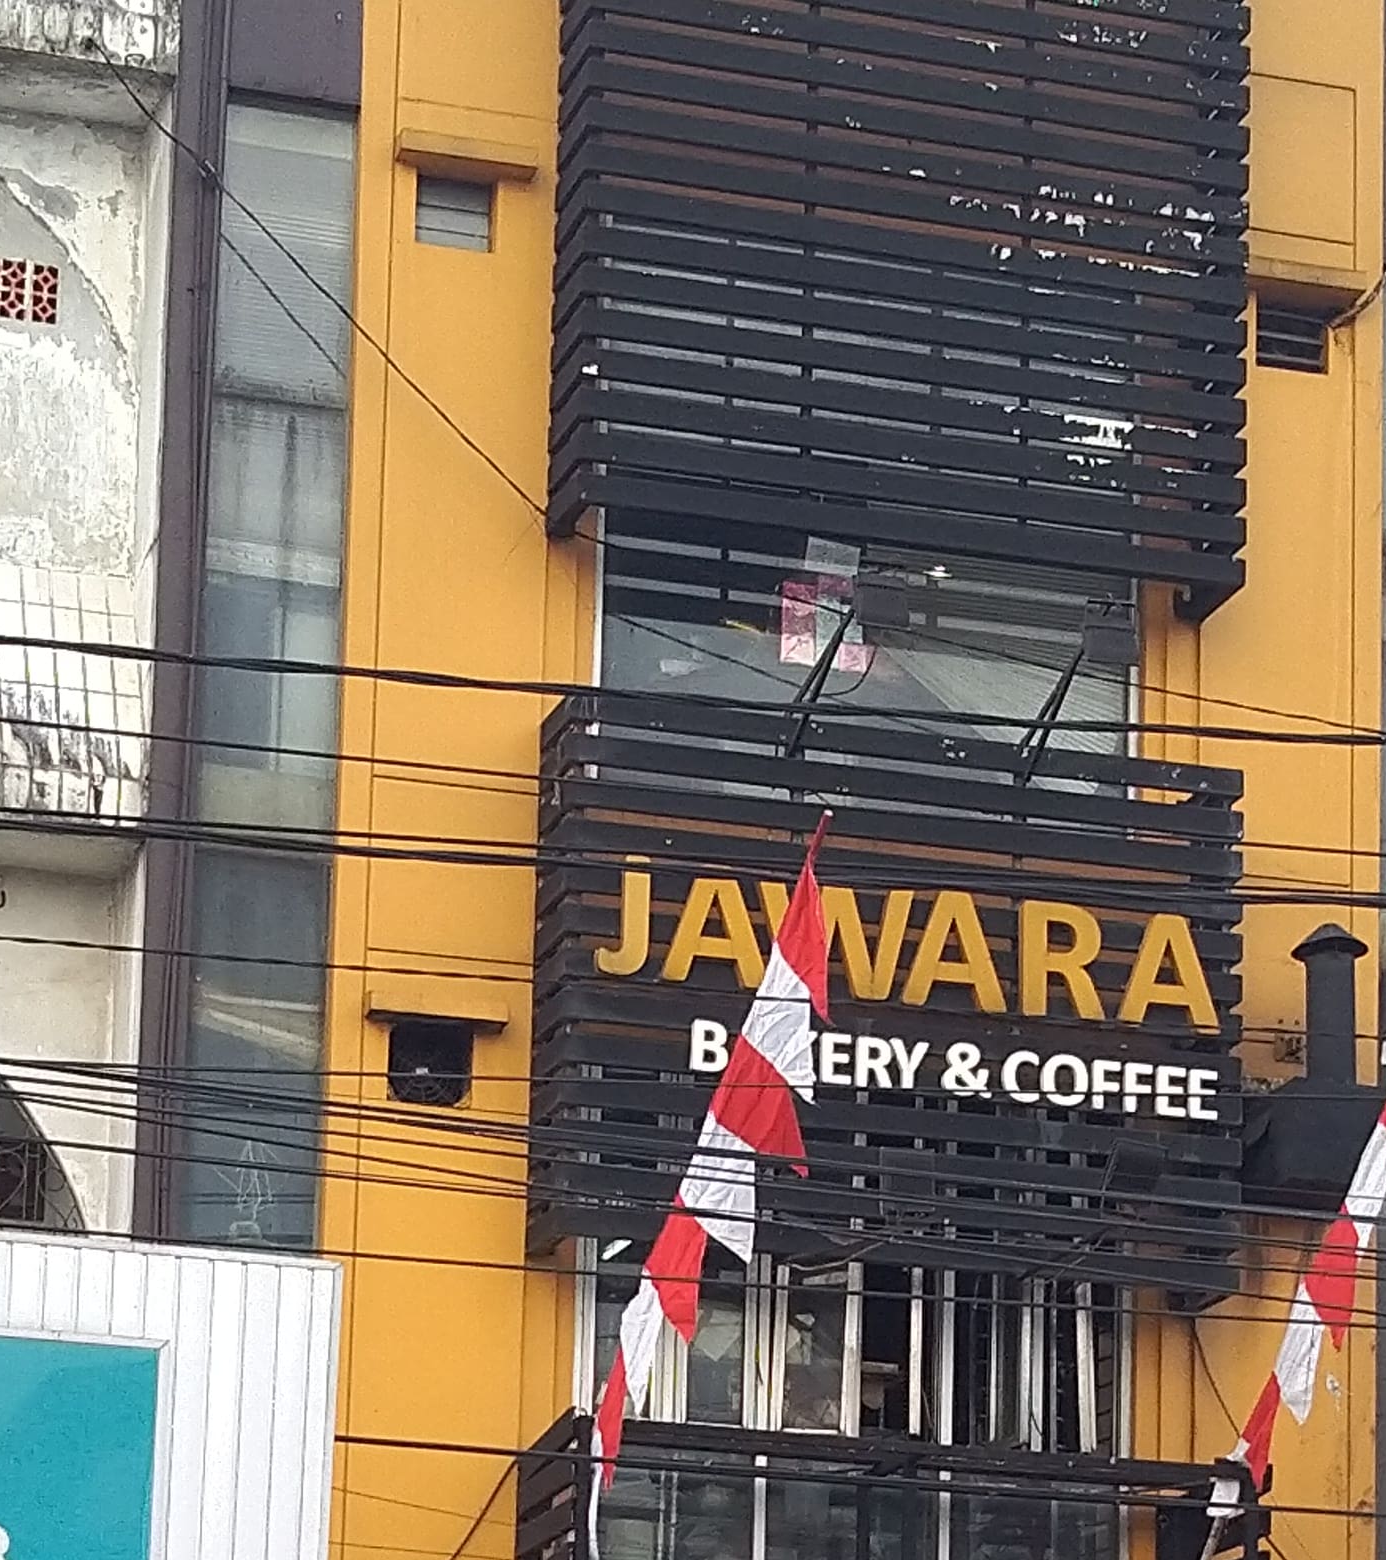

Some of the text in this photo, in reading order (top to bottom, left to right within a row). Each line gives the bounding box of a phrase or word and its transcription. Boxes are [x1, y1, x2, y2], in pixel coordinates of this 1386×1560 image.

[593, 854, 1221, 1035] JAWARA
[688, 1018, 1220, 1122] BERY & COFFEE
